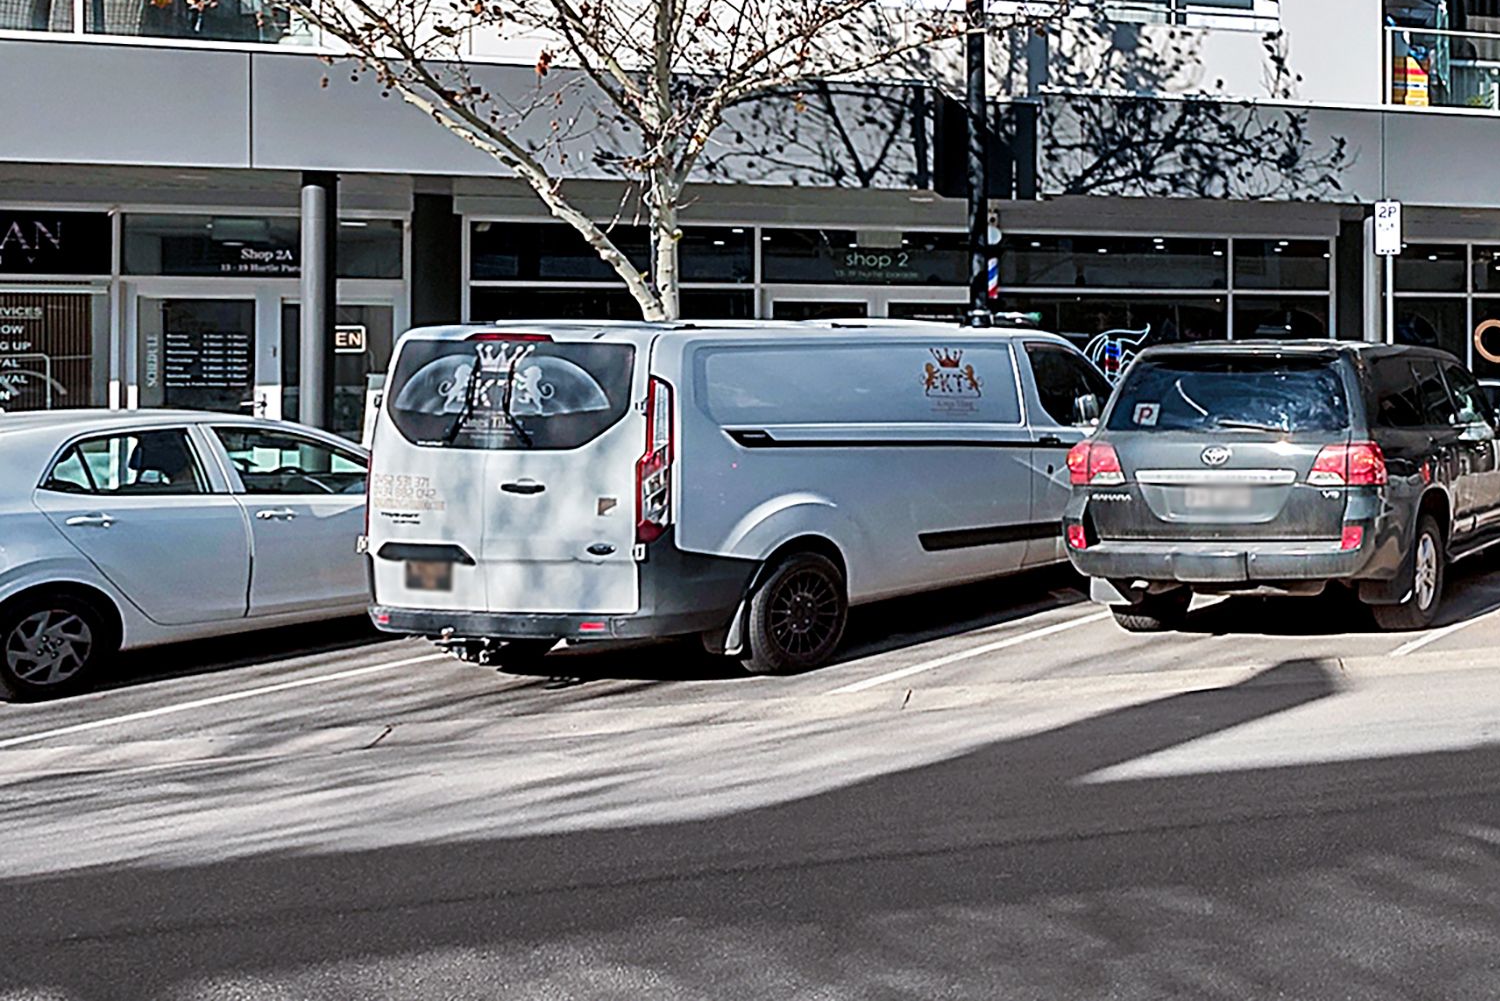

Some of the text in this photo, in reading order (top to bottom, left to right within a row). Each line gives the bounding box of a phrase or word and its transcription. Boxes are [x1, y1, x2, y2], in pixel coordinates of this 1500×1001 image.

[1379, 206, 1397, 218] 2P
[241, 248, 293, 262] Shop 2A
[846, 252, 909, 268] shop 2
[0, 359, 20, 368] AL
[940, 374, 963, 393] KT
